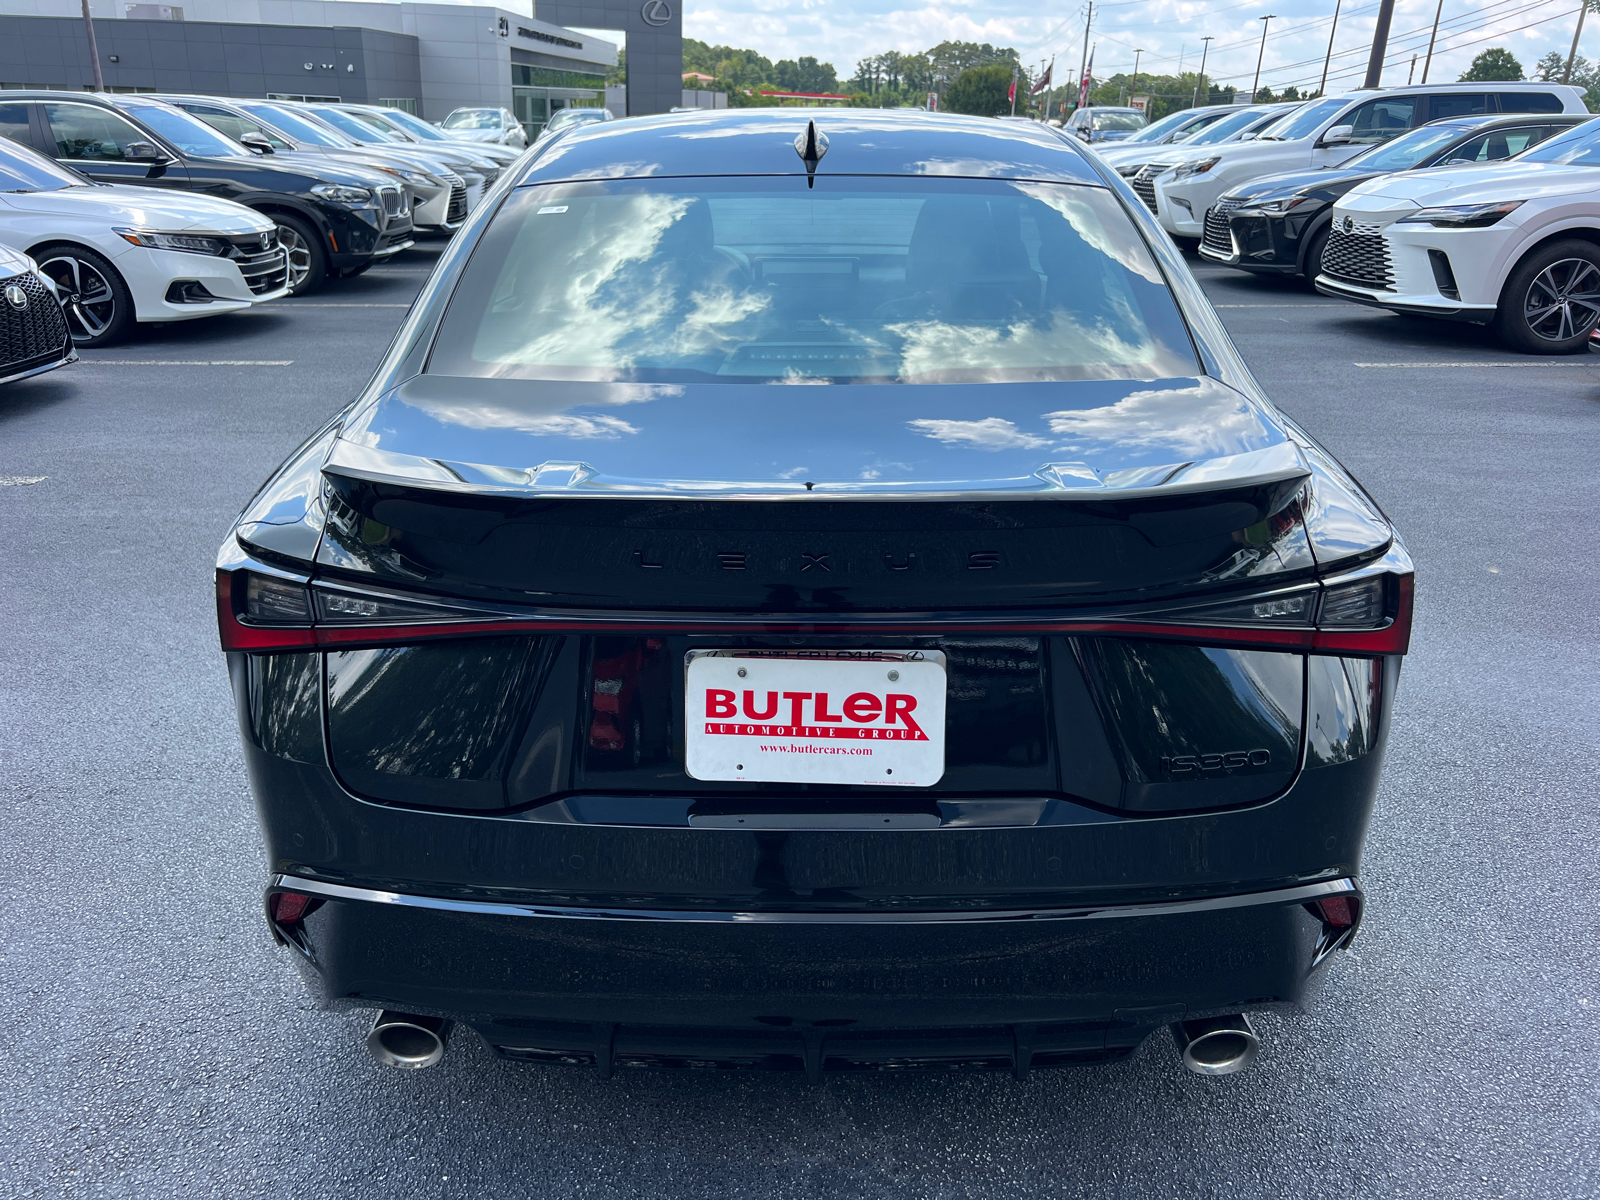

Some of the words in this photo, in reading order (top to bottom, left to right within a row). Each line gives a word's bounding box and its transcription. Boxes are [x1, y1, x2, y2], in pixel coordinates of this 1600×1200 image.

[633, 550, 1001, 572] LEXUS
[706, 724, 836, 737] AUTOMOTIVE
[858, 728, 922, 740] GROUP
[760, 743, 873, 756] www.butlercars.com
